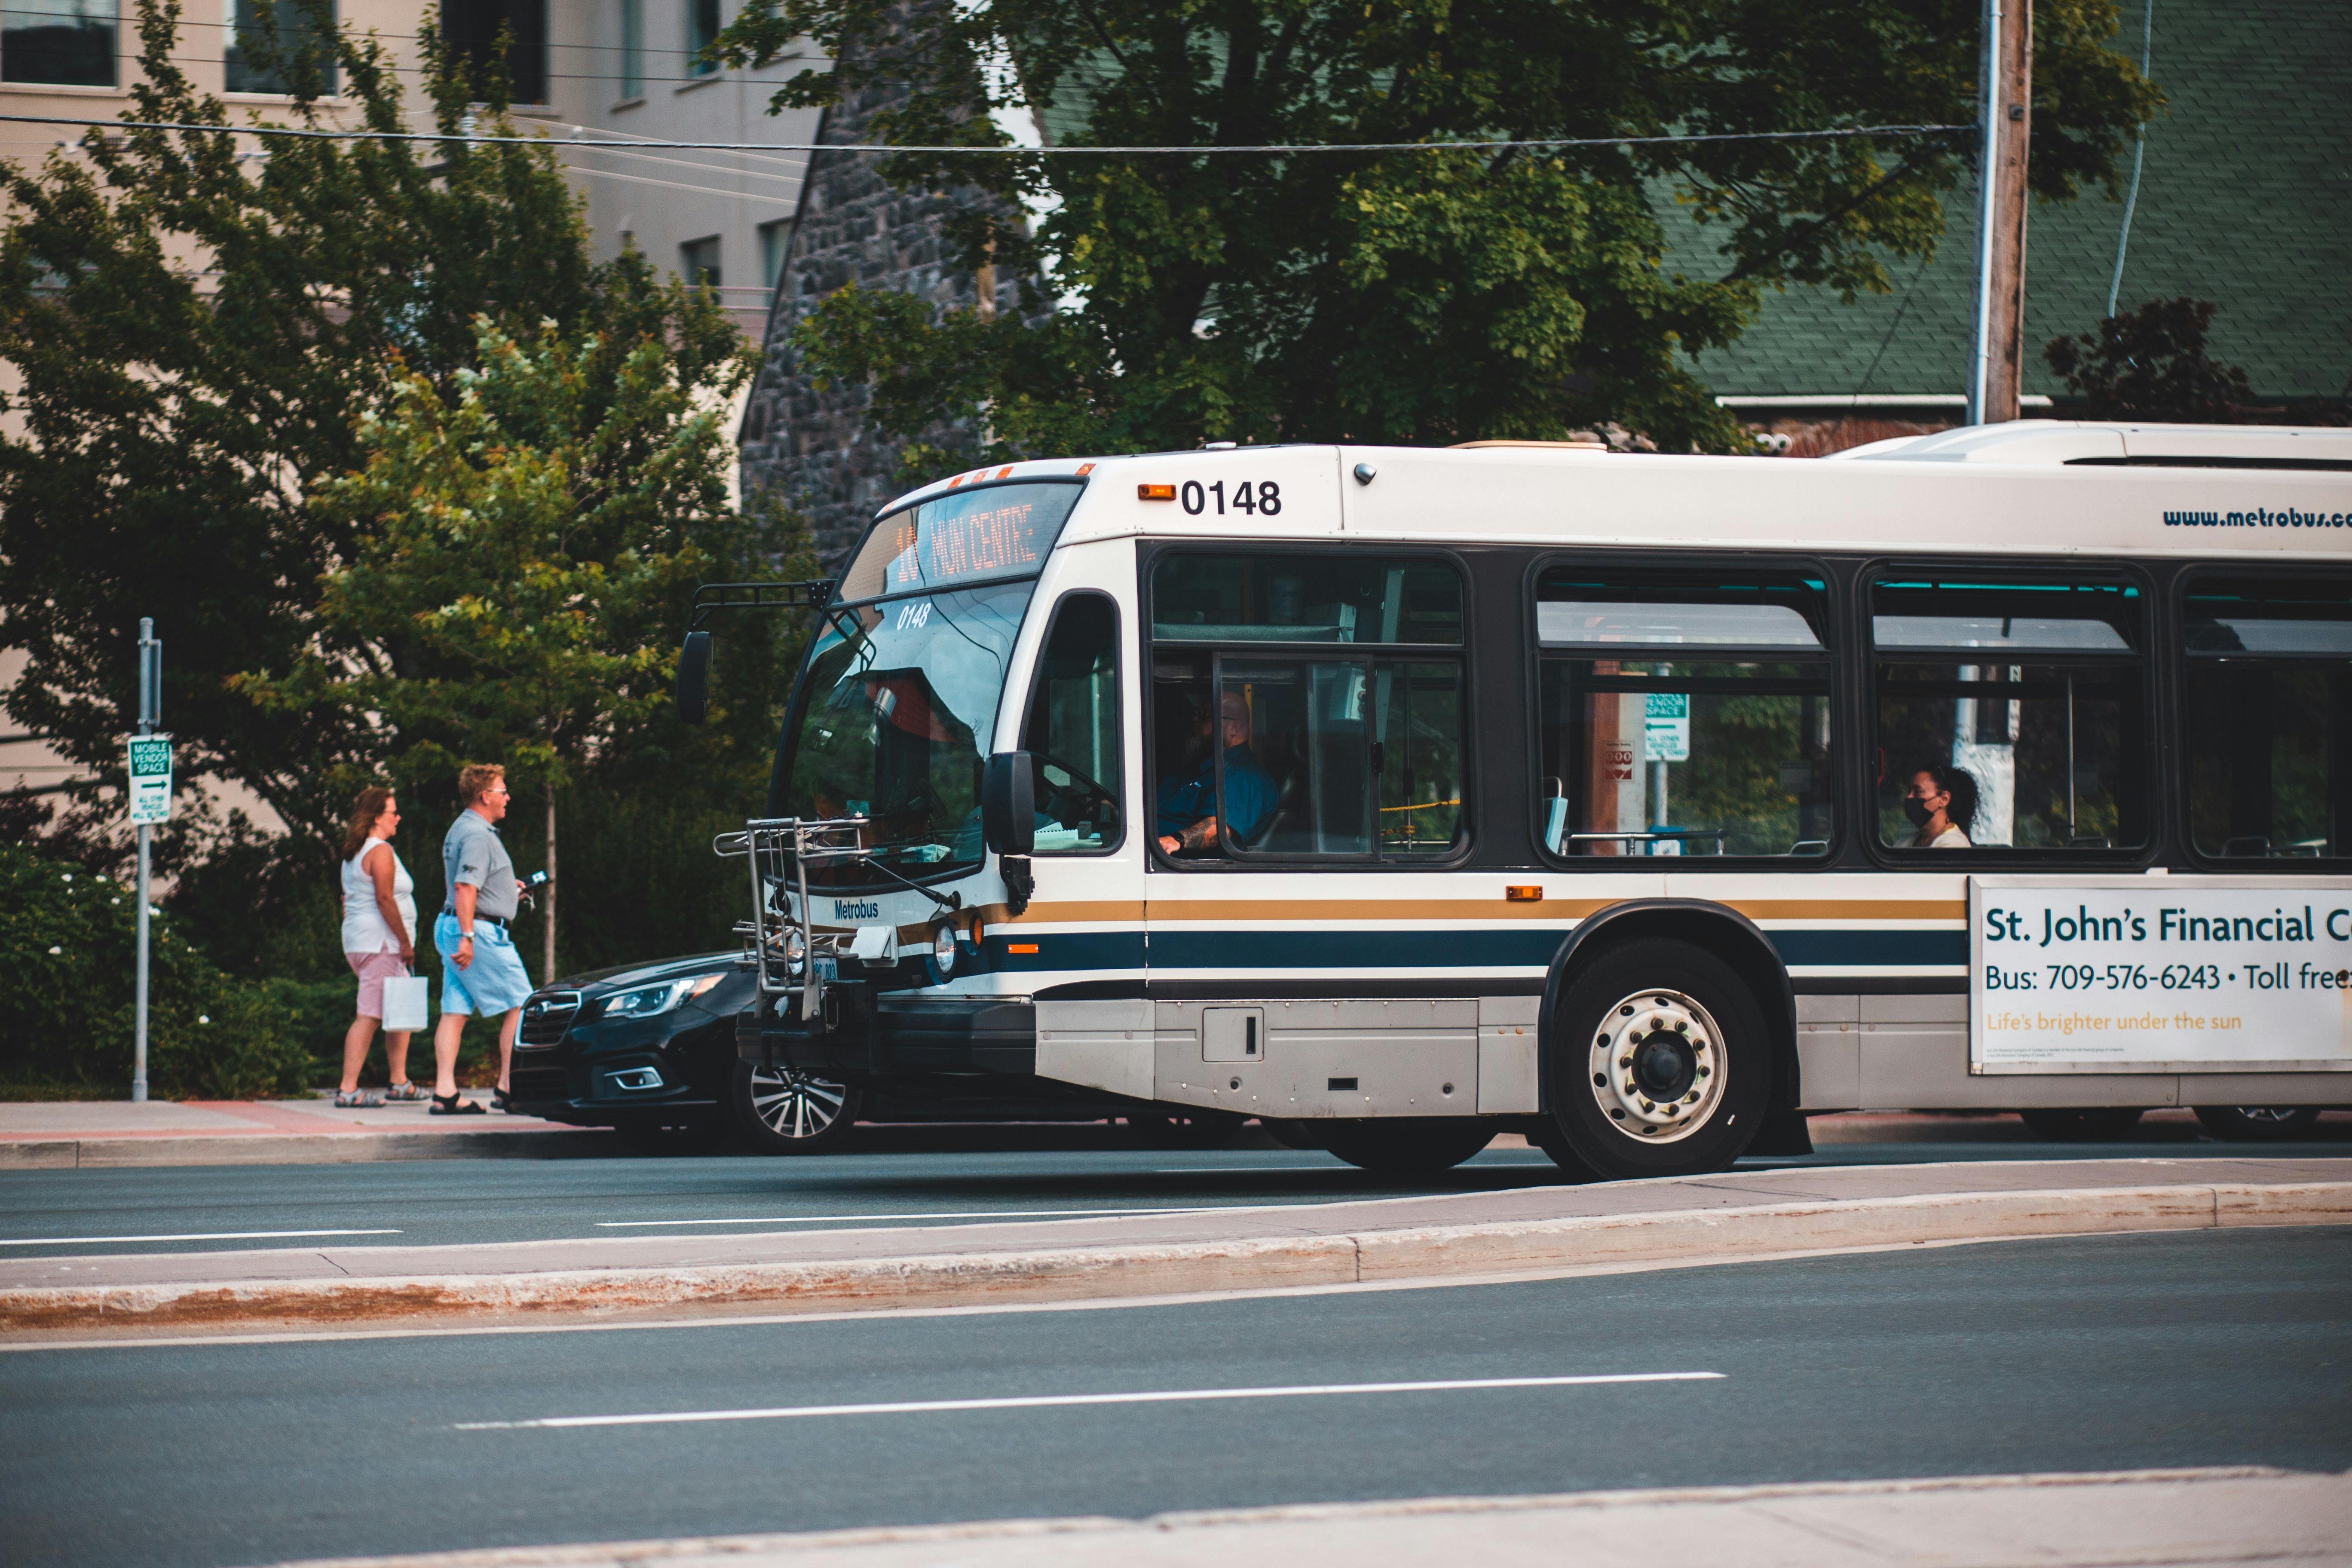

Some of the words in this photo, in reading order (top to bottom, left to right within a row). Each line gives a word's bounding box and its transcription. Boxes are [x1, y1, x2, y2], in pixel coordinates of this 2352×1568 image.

[1182, 480, 1281, 515] 0148
[896, 526, 919, 582] 10
[931, 517, 967, 577] MUN
[970, 504, 1036, 570] CENTRE
[897, 603, 931, 630] 0148
[1646, 706, 1678, 715] SPACE
[134, 752, 167, 763] VENDOR
[135, 743, 166, 753] MOBILE
[138, 763, 165, 773] SPACE
[835, 899, 878, 919] Metrobus
[1986, 908, 2030, 941] St.
[2039, 905, 2147, 947] John's
[2160, 905, 2315, 941] Financial
[2327, 909, 2352, 941] C
[825, 962, 836, 980] 823
[1986, 965, 2037, 989] Bus:
[2047, 965, 2220, 989] 709-576-6243
[2243, 962, 2289, 989] Toll
[1987, 1012, 2031, 1031] Life's
[2037, 1011, 2110, 1035] brighter
[2116, 1011, 2168, 1030] under
[2174, 1011, 2205, 1030] the
[2211, 1014, 2242, 1030] sun
